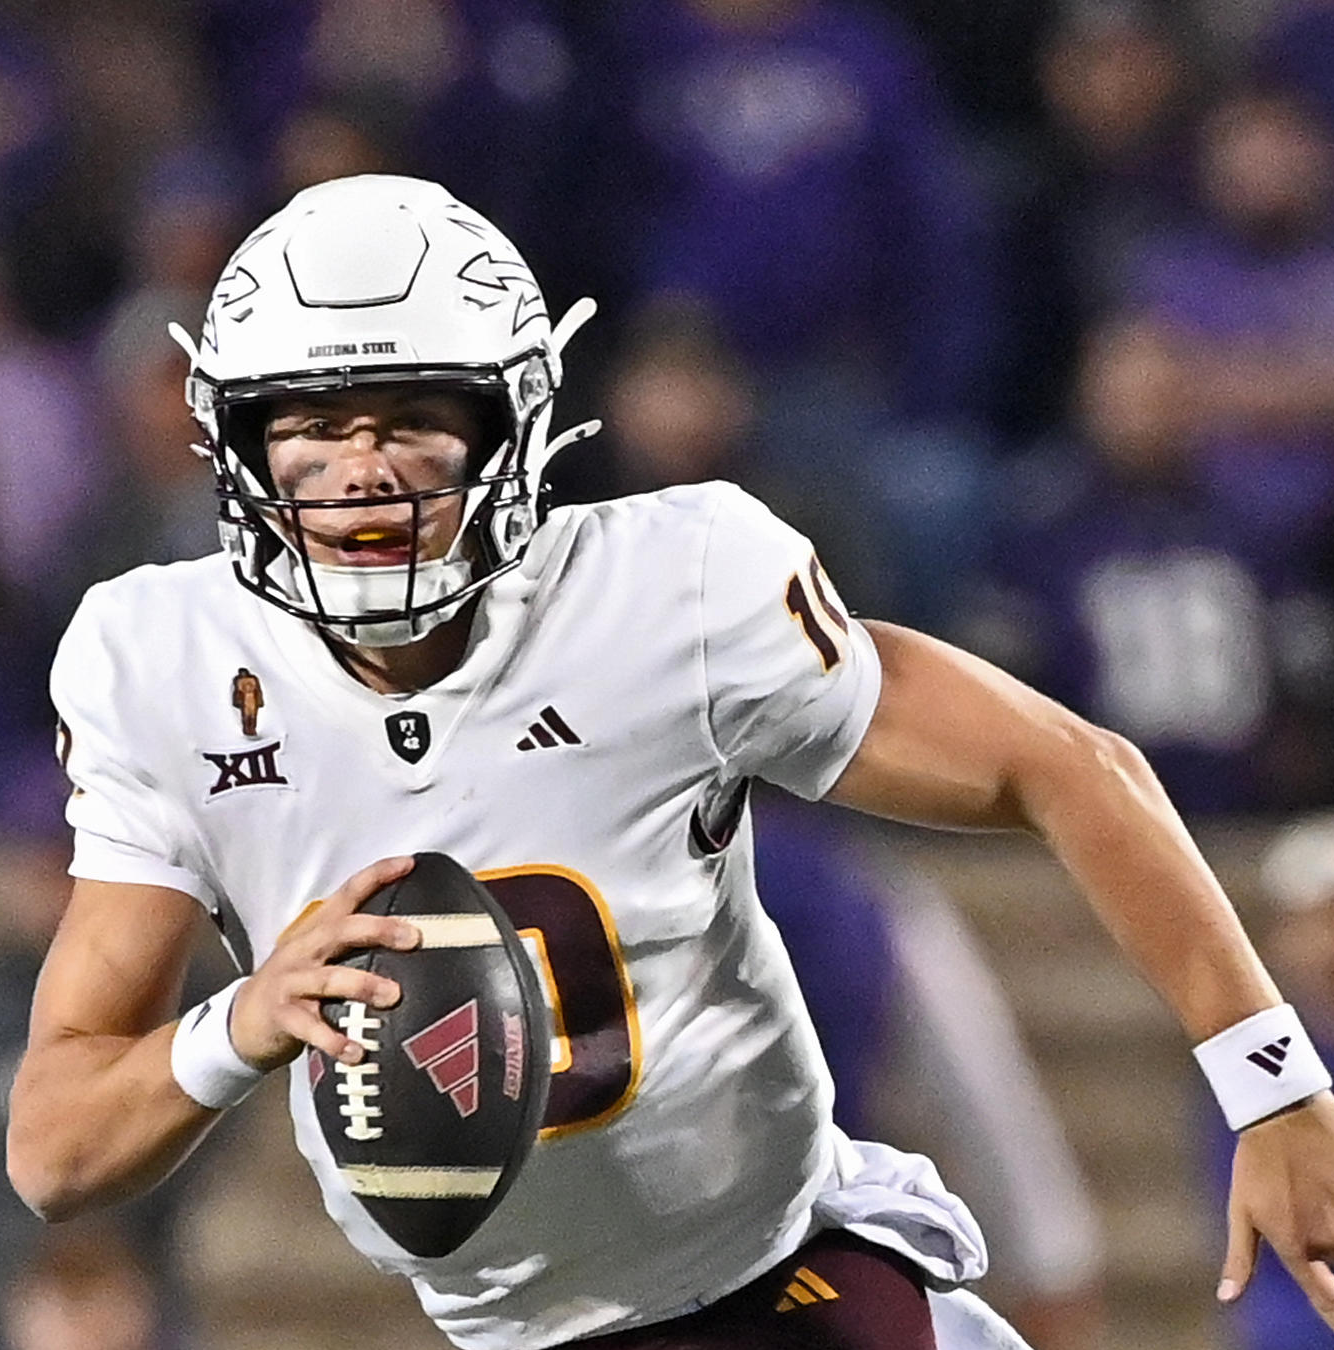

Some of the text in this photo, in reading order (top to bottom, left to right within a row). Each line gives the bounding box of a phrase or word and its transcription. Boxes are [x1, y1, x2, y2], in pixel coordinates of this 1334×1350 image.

[307, 341, 398, 359] ARIZONA STATE
[399, 718, 416, 733] PT
[201, 740, 288, 795] XII
